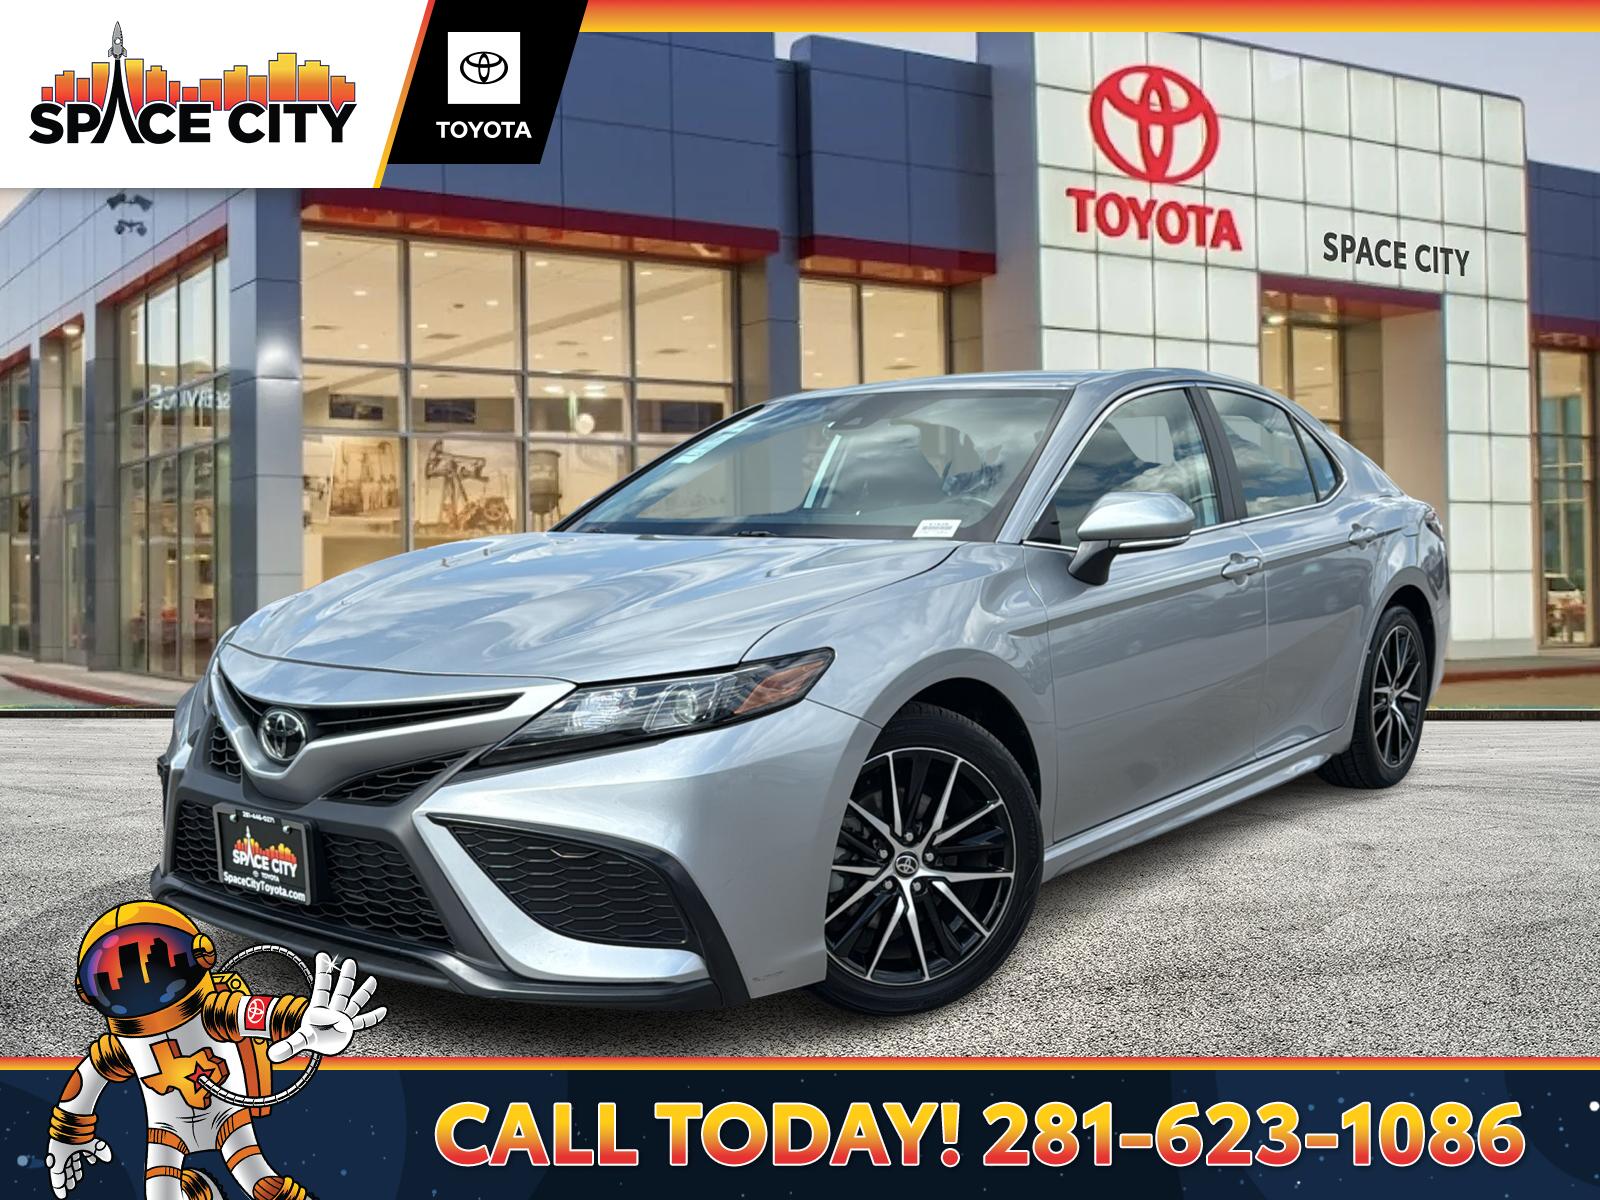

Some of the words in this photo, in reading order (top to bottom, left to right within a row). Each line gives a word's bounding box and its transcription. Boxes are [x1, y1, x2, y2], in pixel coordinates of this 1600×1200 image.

[1066, 188, 1242, 251] TOYOTA
[1323, 232, 1407, 270] SPACE
[1414, 244, 1470, 276] CITY
[232, 848, 269, 870] SPACE
[271, 858, 297, 878] CITY
[261, 872, 279, 882] TOYOTA
[223, 871, 306, 902] SpaceCityToyota.com
